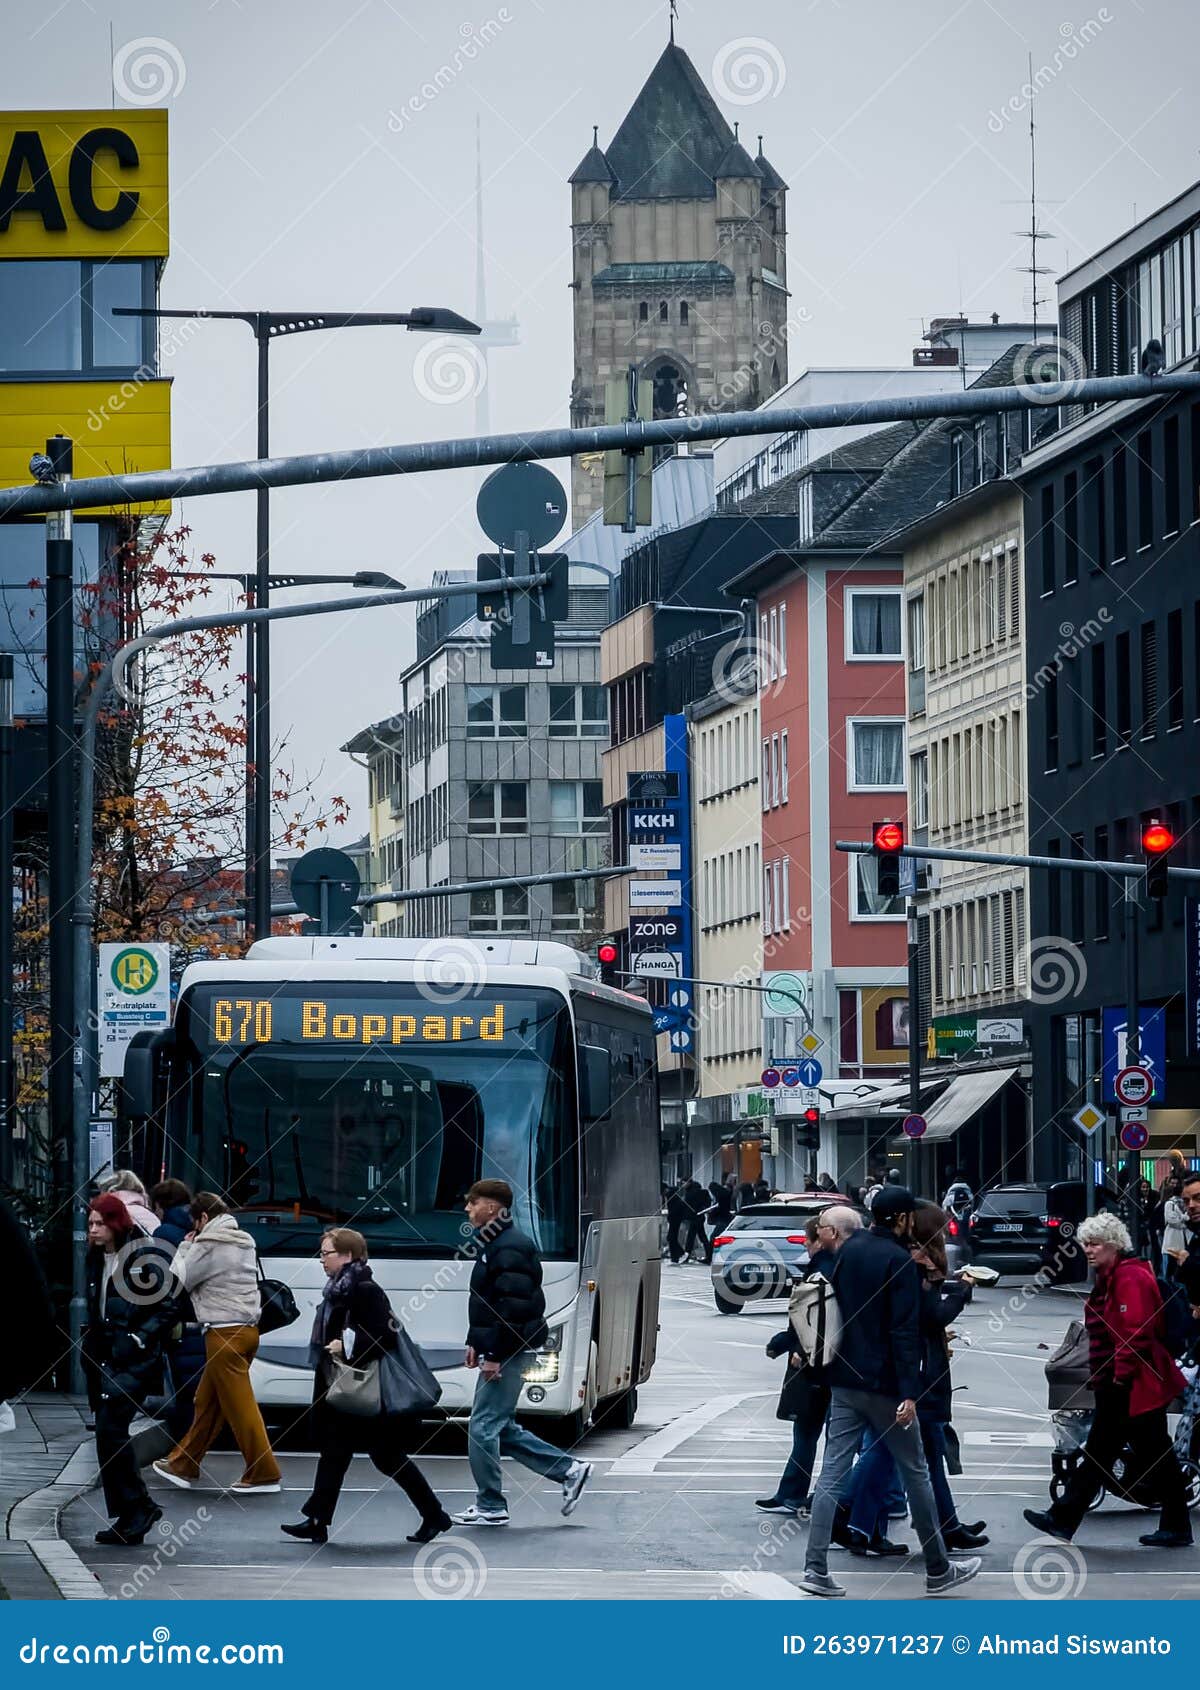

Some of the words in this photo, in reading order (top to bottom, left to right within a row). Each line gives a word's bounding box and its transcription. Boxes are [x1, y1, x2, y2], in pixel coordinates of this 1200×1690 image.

[634, 814, 675, 828] KKH
[635, 923, 677, 936] zone
[215, 1000, 272, 1042] 670
[302, 1001, 504, 1044] Boppard
